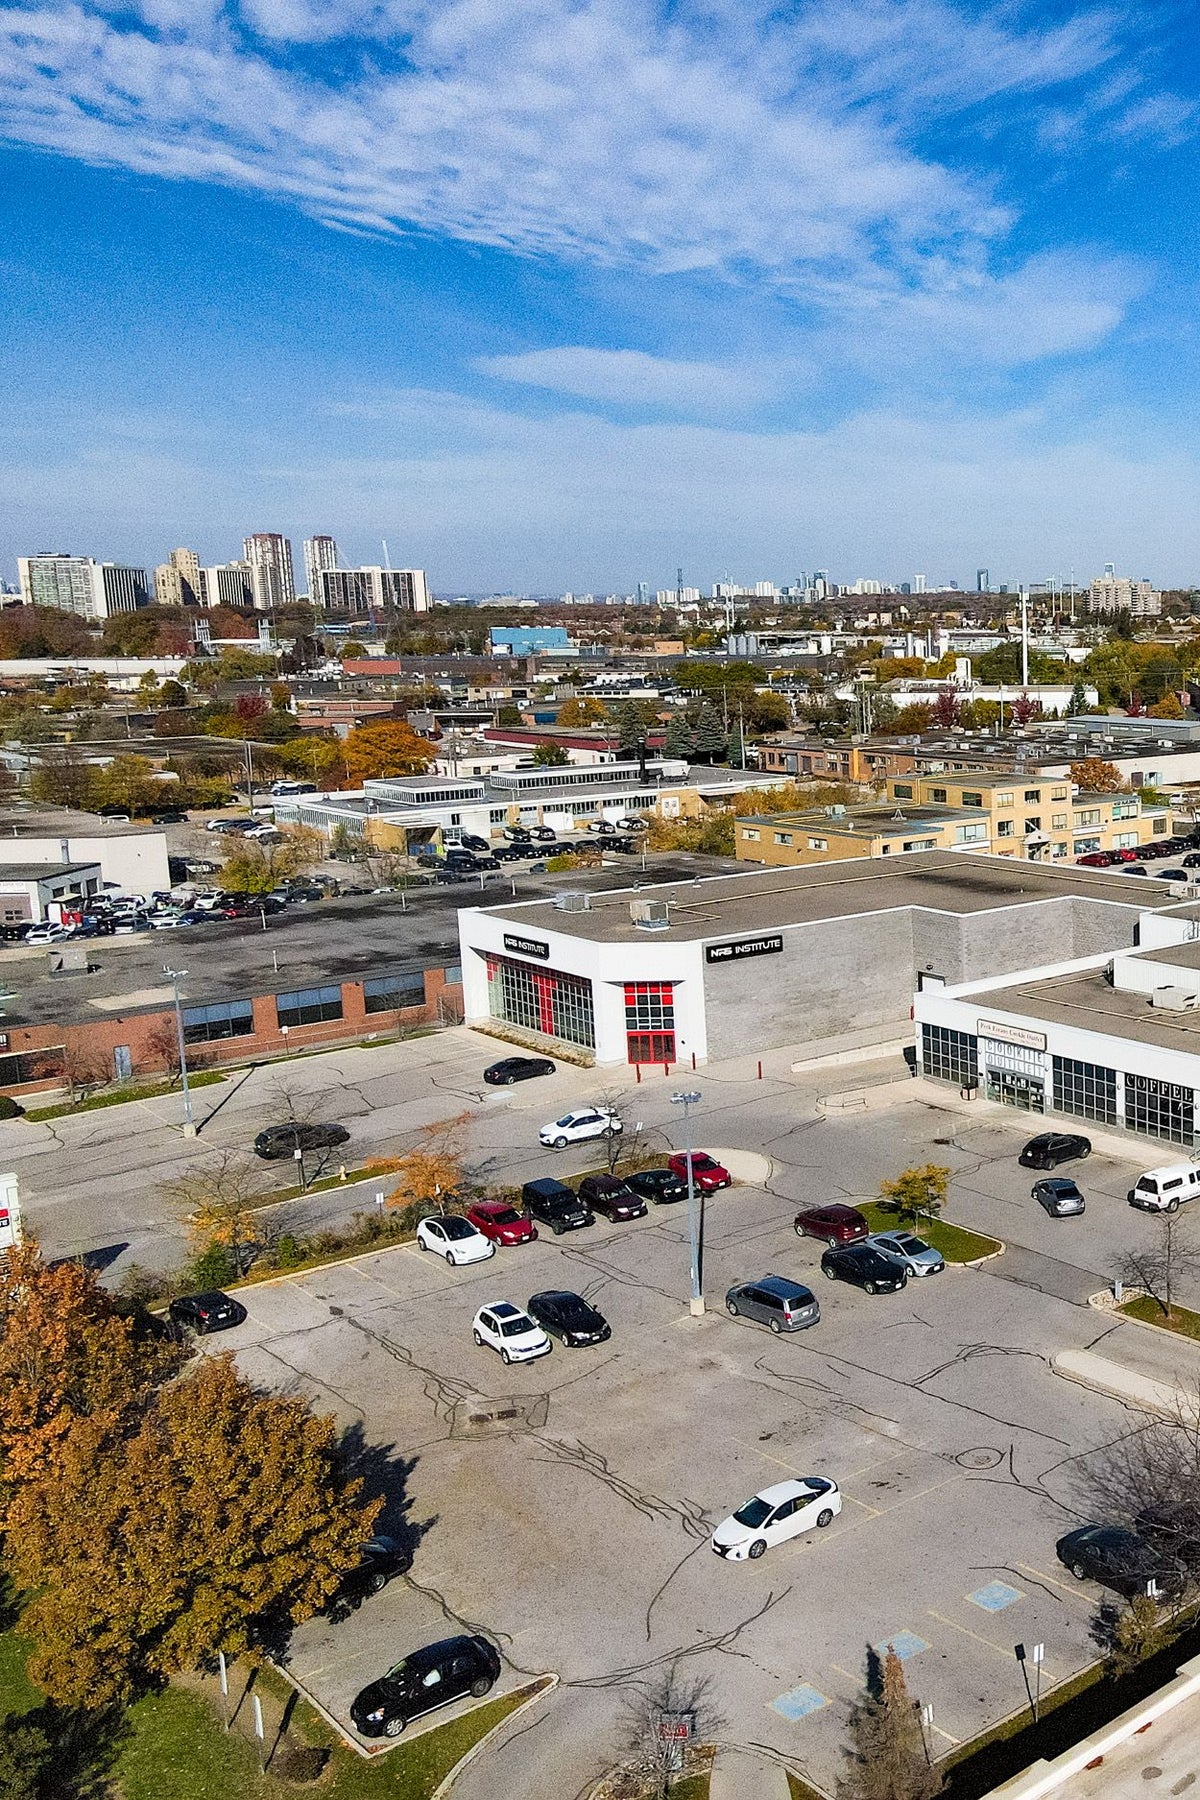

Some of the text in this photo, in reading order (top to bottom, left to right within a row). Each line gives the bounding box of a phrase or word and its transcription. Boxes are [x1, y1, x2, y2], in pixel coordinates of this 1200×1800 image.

[711, 939, 781, 958] NRS INSTITUTE
[987, 1041, 1043, 1063] COOKIE
[987, 1054, 1043, 1076] OUTLET
[1126, 1074, 1193, 1101] COFFEE
